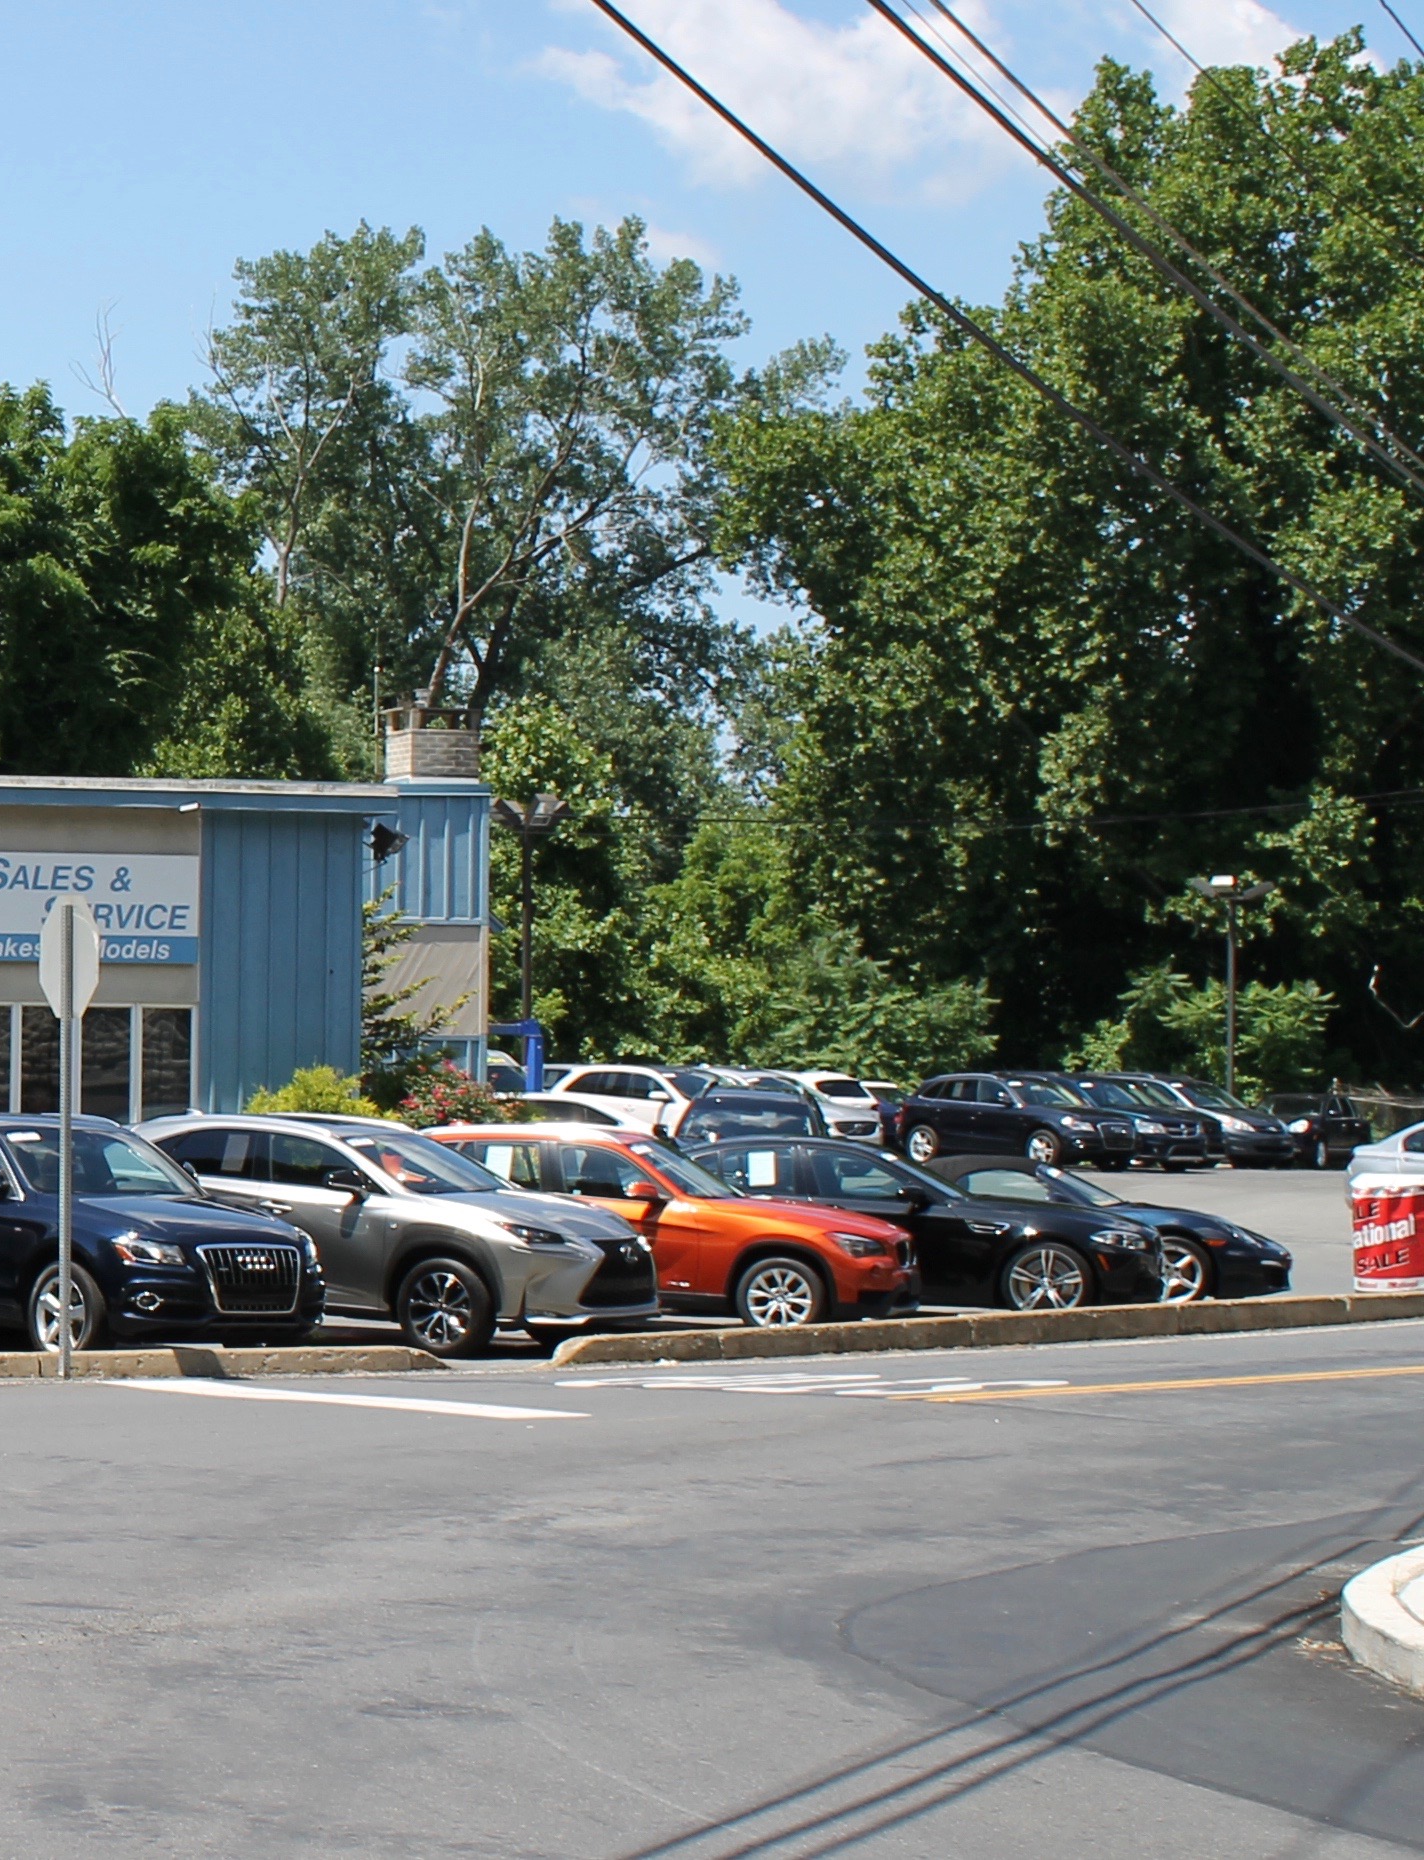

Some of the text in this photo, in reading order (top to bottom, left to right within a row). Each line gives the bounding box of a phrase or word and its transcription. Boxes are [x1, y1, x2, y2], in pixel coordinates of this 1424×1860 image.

[109, 866, 132, 892] &
[41, 897, 190, 930] RVICE
[1353, 1213, 1415, 1250] ational
[1357, 1247, 1410, 1275] SALE
